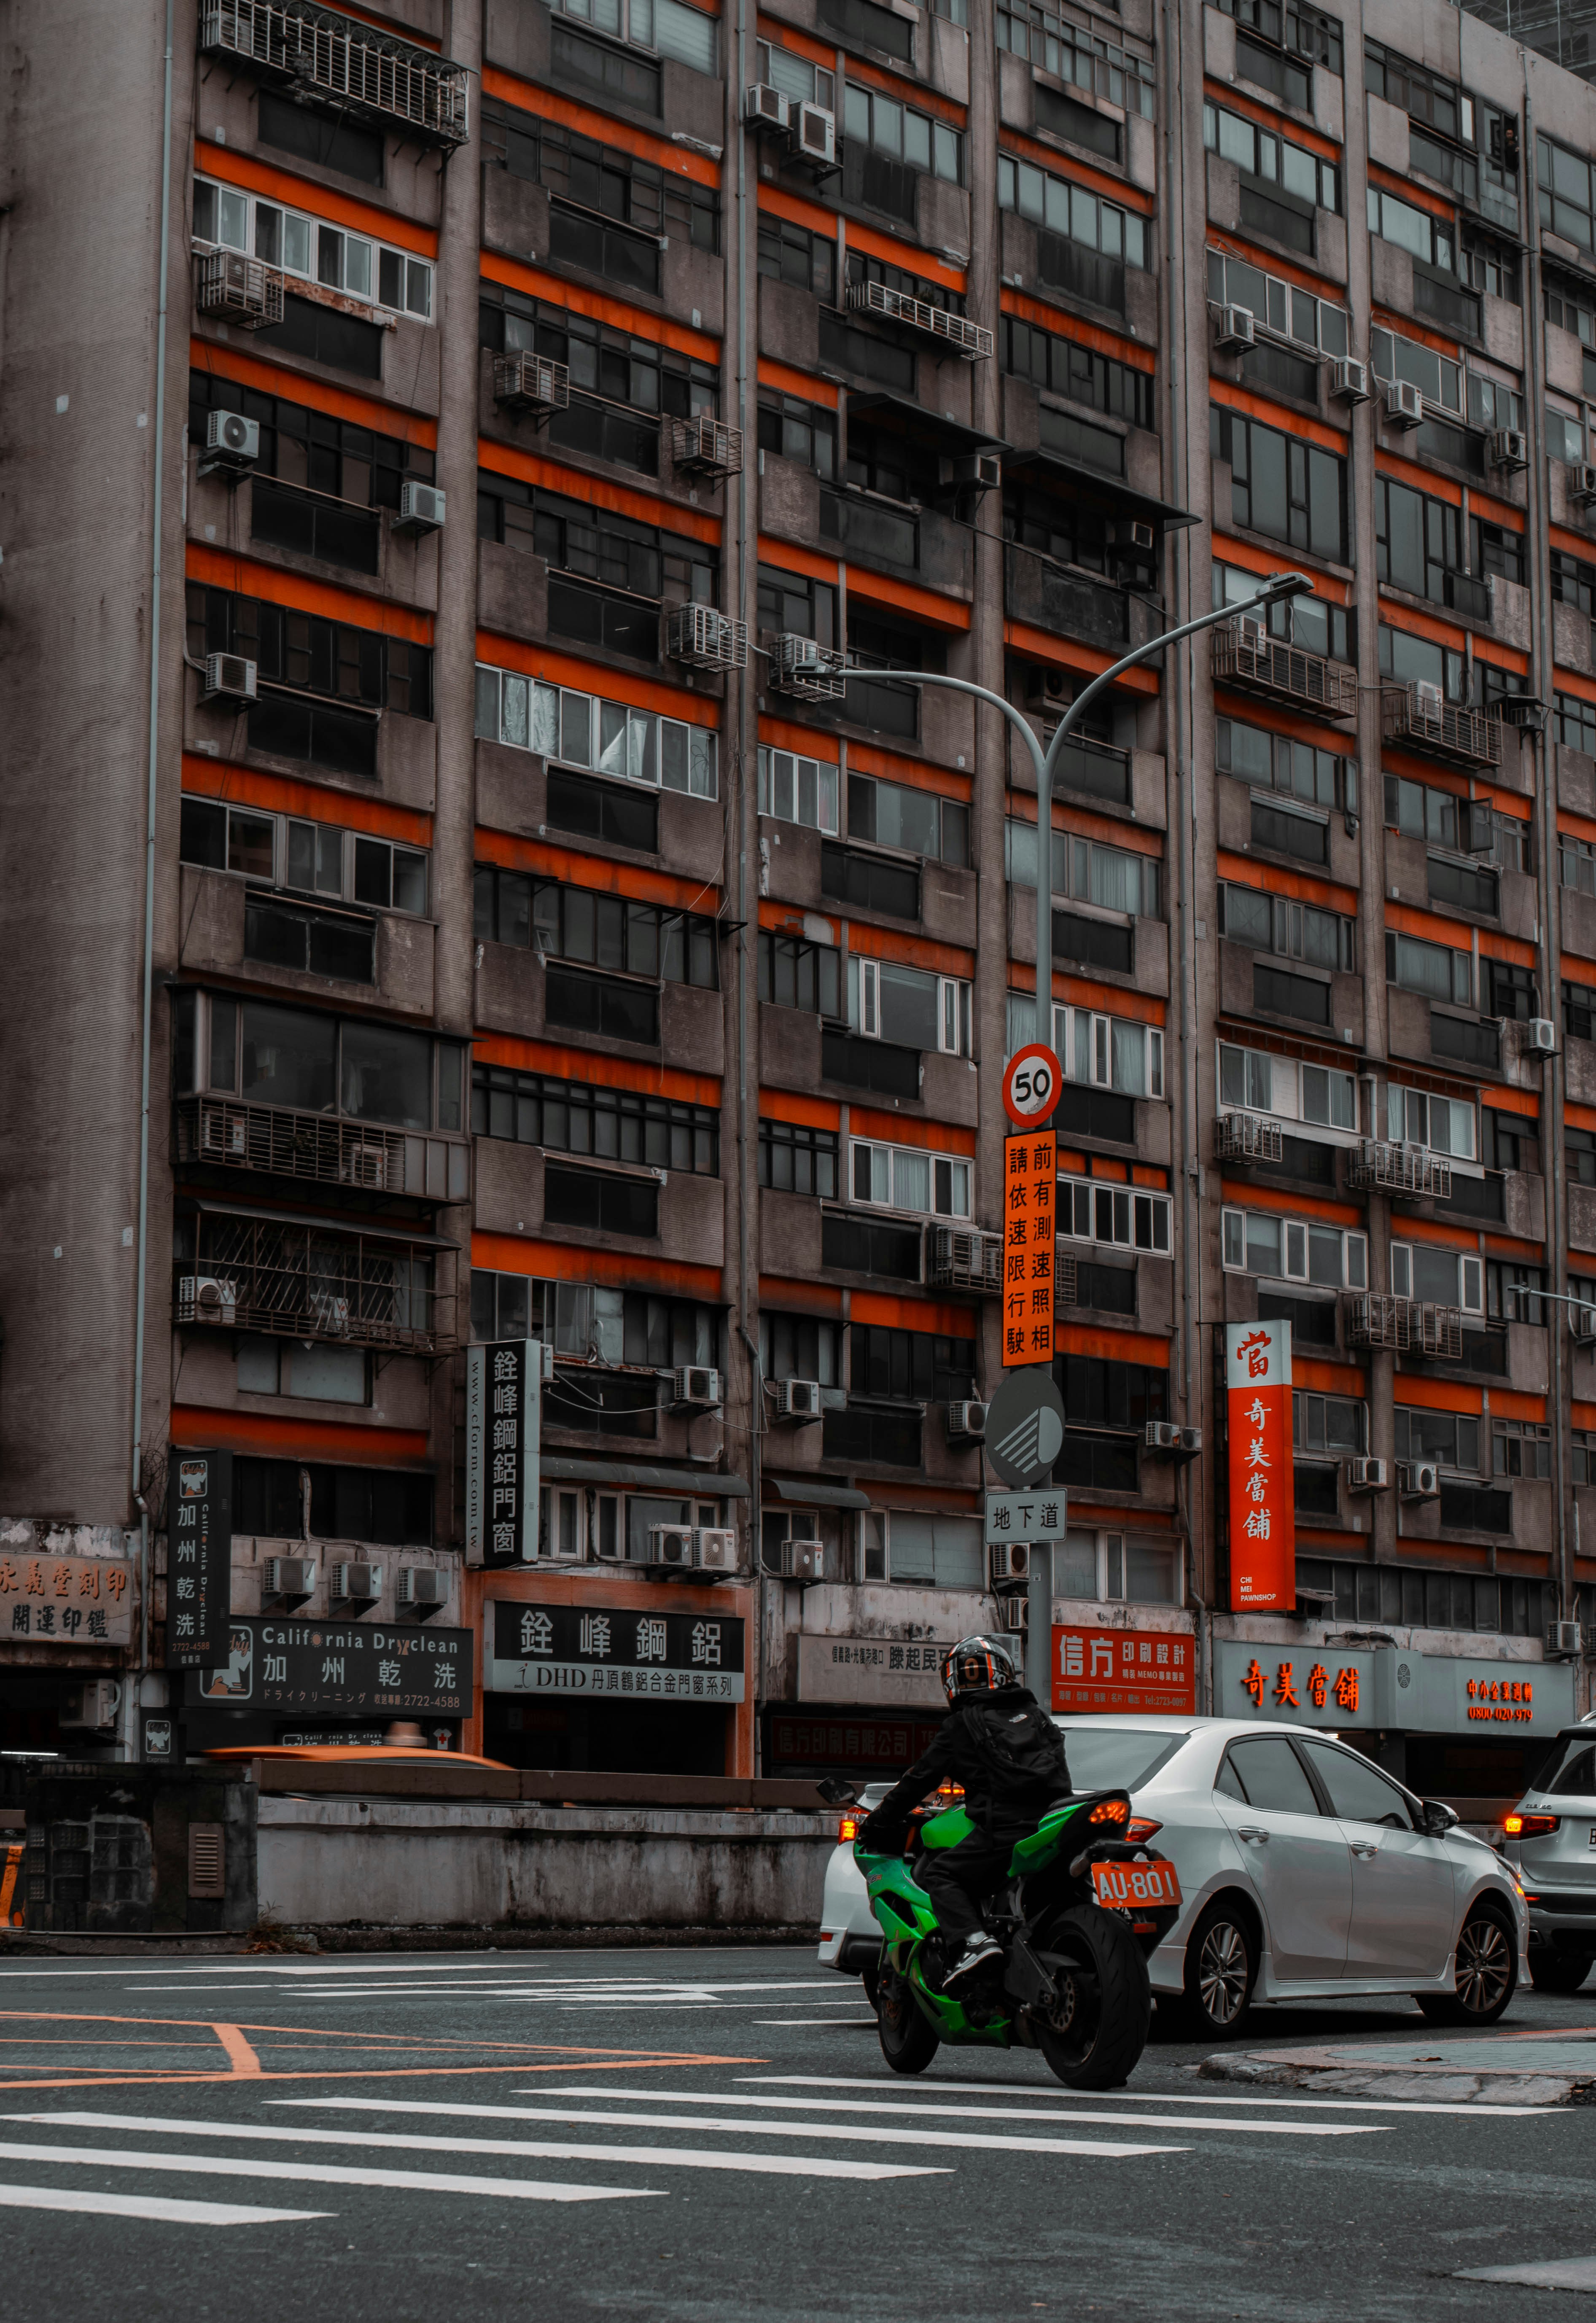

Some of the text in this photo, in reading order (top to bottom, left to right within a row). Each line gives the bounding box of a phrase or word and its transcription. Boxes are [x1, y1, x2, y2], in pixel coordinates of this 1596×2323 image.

[1015, 1069, 1050, 1102] 50
[1006, 1146, 1028, 1355] 請依速限行駛
[1031, 1143, 1052, 1351] 前有測速照相
[1237, 1330, 1272, 1378] 當
[471, 1361, 480, 1548] www.cform.com.tw
[493, 1351, 518, 1553] 銓峰鋼鋁門窗
[993, 1503, 1059, 1530] 地下道
[176, 1504, 196, 1636] 加州乾洗
[1240, 1594, 1276, 1602] PAWNSHOP
[12, 1604, 108, 1638] 開運印鑑
[521, 1609, 721, 1665] 銓峰鋼鋁
[172, 1642, 210, 1652] 2722-4588
[262, 1626, 458, 1655] California Dryclean
[1059, 1634, 1114, 1678] 信方
[1122, 1642, 1185, 1665] 印刷設計
[263, 1653, 456, 1689] 加州乾洗
[536, 1667, 732, 1696] DHD 丹頂鶴鋁合金門窗系列
[1137, 1671, 1157, 1679] MEMO
[264, 1689, 366, 1704] ドライクリーニング
[1467, 1707, 1533, 1722] 0800-020-979
[1099, 1871, 1174, 1900] AU-801
